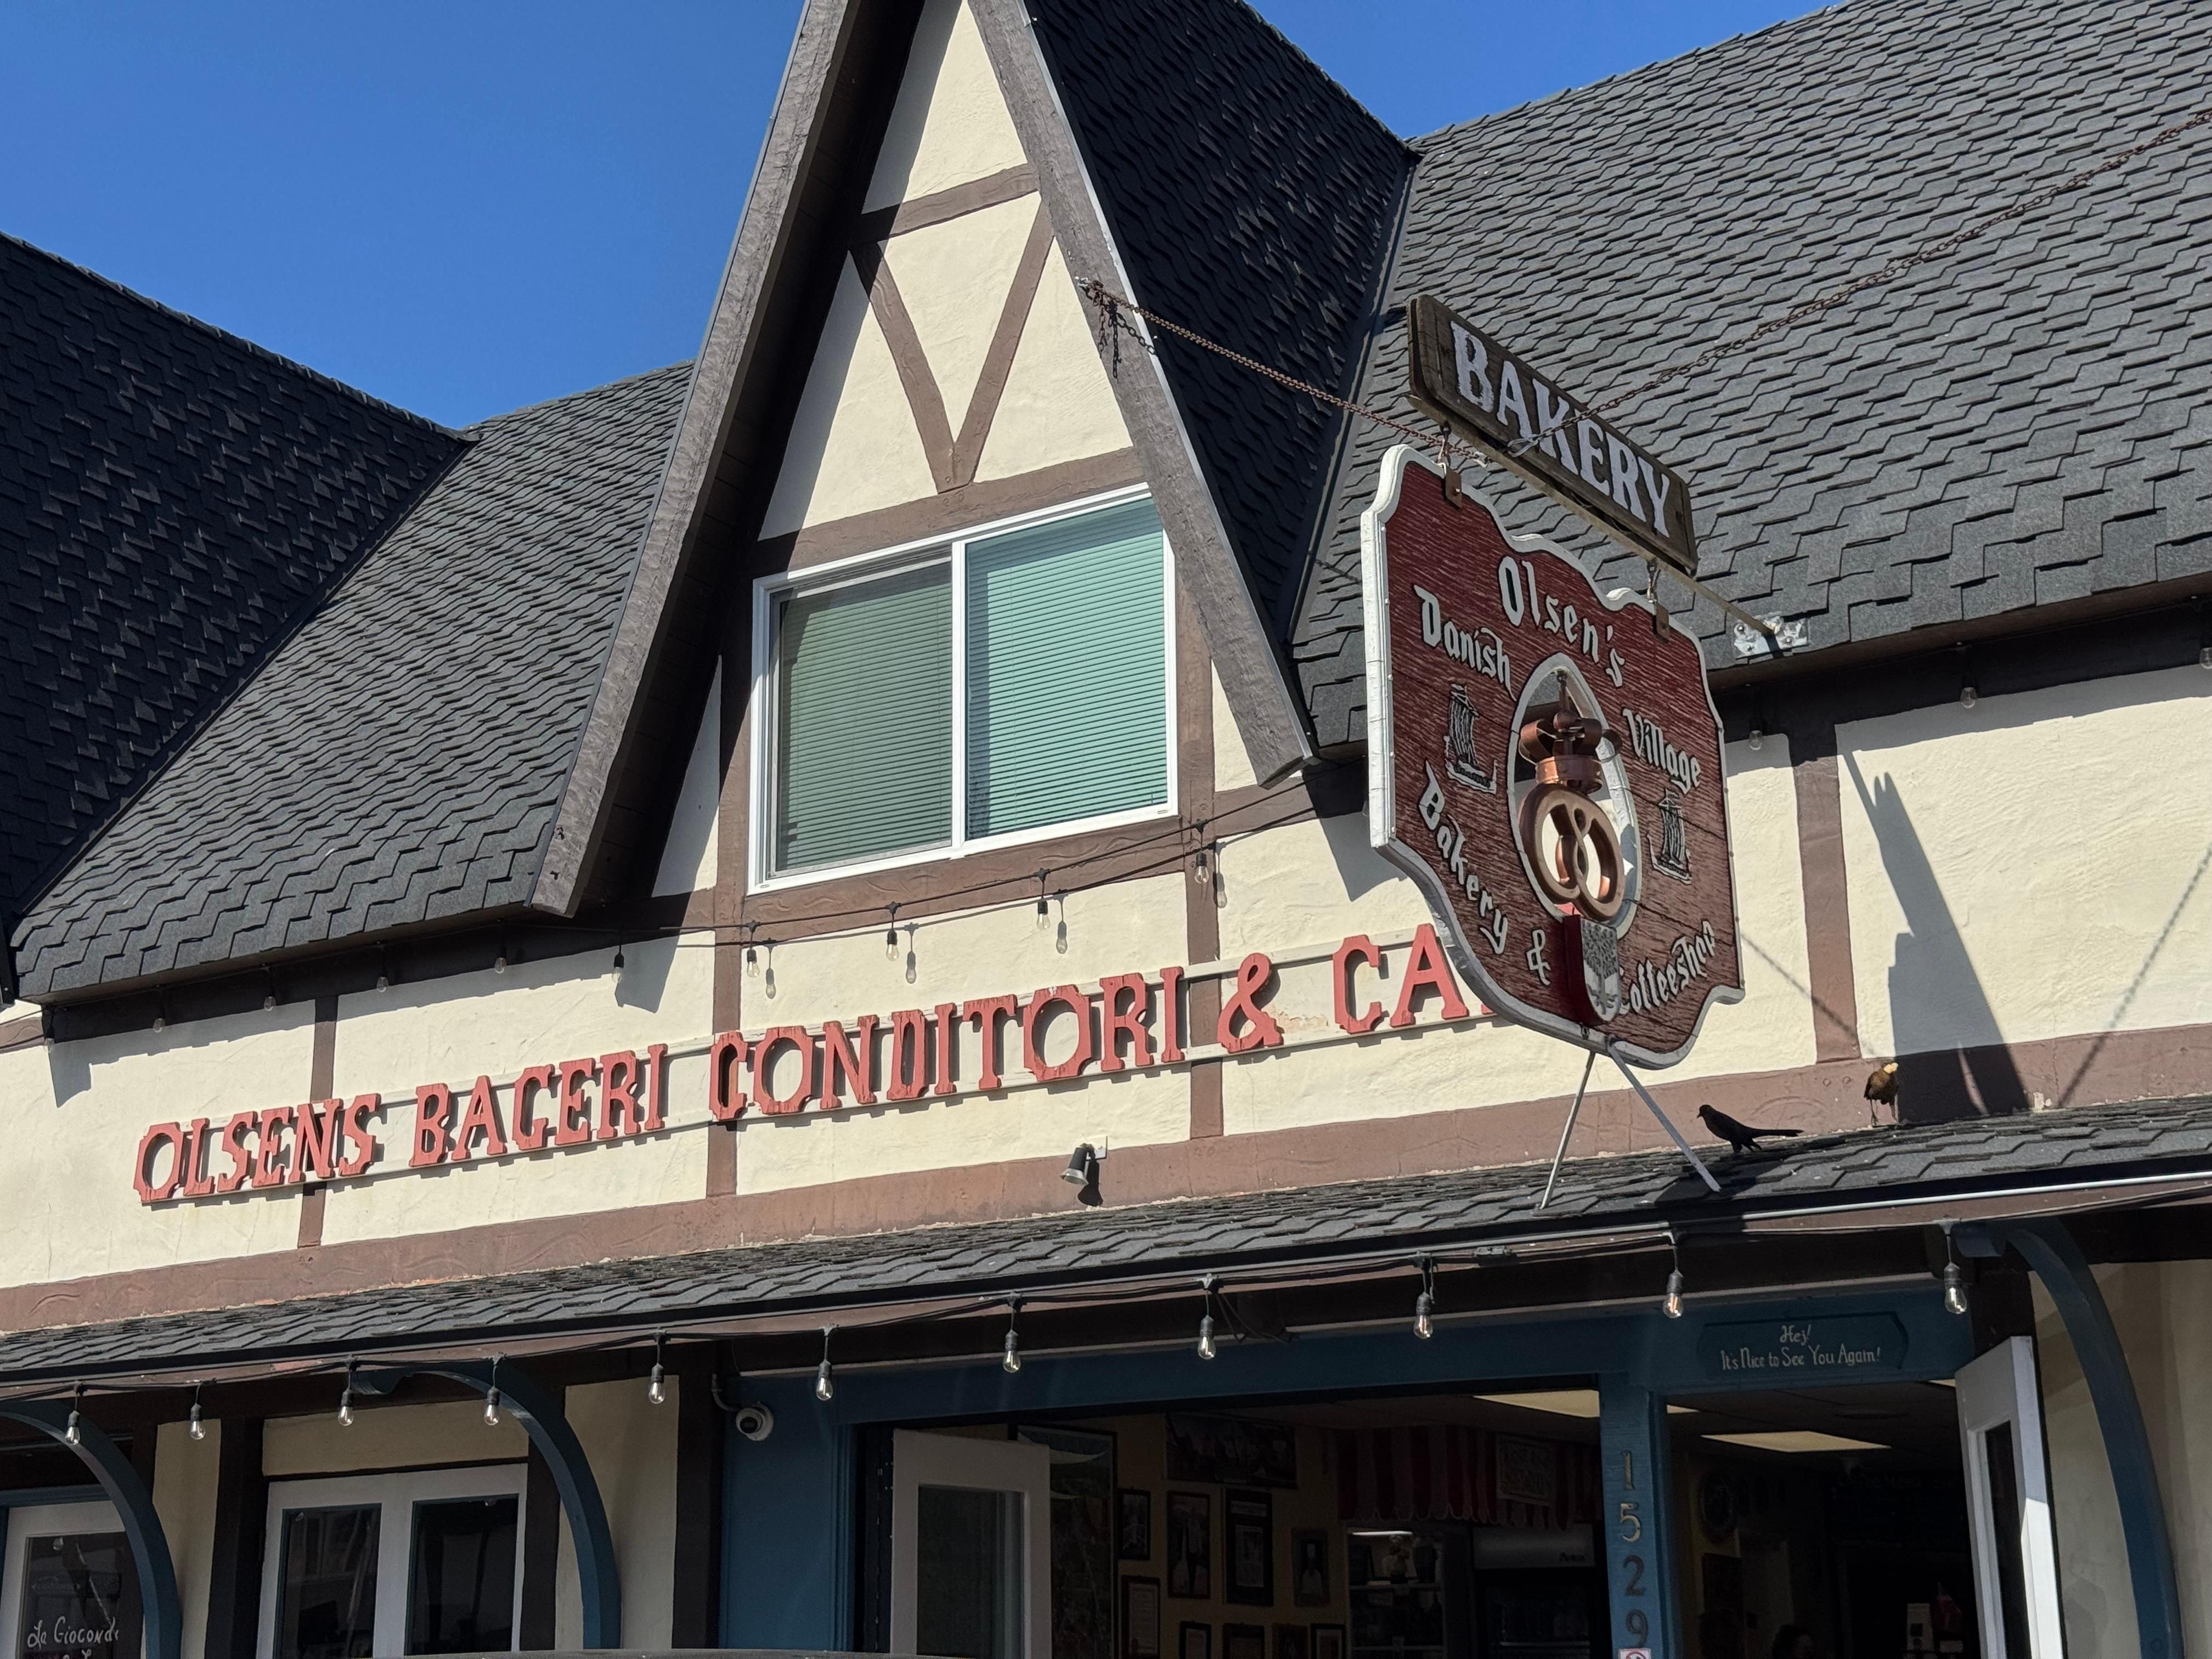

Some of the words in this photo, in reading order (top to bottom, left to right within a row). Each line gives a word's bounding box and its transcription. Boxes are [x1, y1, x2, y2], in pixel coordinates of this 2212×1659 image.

[1450, 321, 1670, 538] BAKERY
[1413, 584, 1516, 701] Danish
[1499, 556, 1625, 687] Olsen's
[1622, 708, 1701, 794] Village
[1419, 760, 1508, 955] Bakery
[1526, 927, 1550, 985] &
[133, 1093, 381, 1203] OLSENS
[409, 1043, 667, 1167] BAGERI
[710, 967, 1185, 1121] CONDITORI
[1218, 953, 1284, 1053] &
[1333, 924, 1497, 1034] CA
[1720, 1350, 1739, 1370] It's
[1740, 1347, 1764, 1368] Nice
[1769, 1352, 1779, 1367] to
[1781, 1346, 1805, 1367] See
[1808, 1344, 1835, 1365] You
[1838, 1343, 1881, 1365] Again!
[1780, 1324, 1810, 1345] Hej!
[1620, 1450, 1649, 1646] 1529
